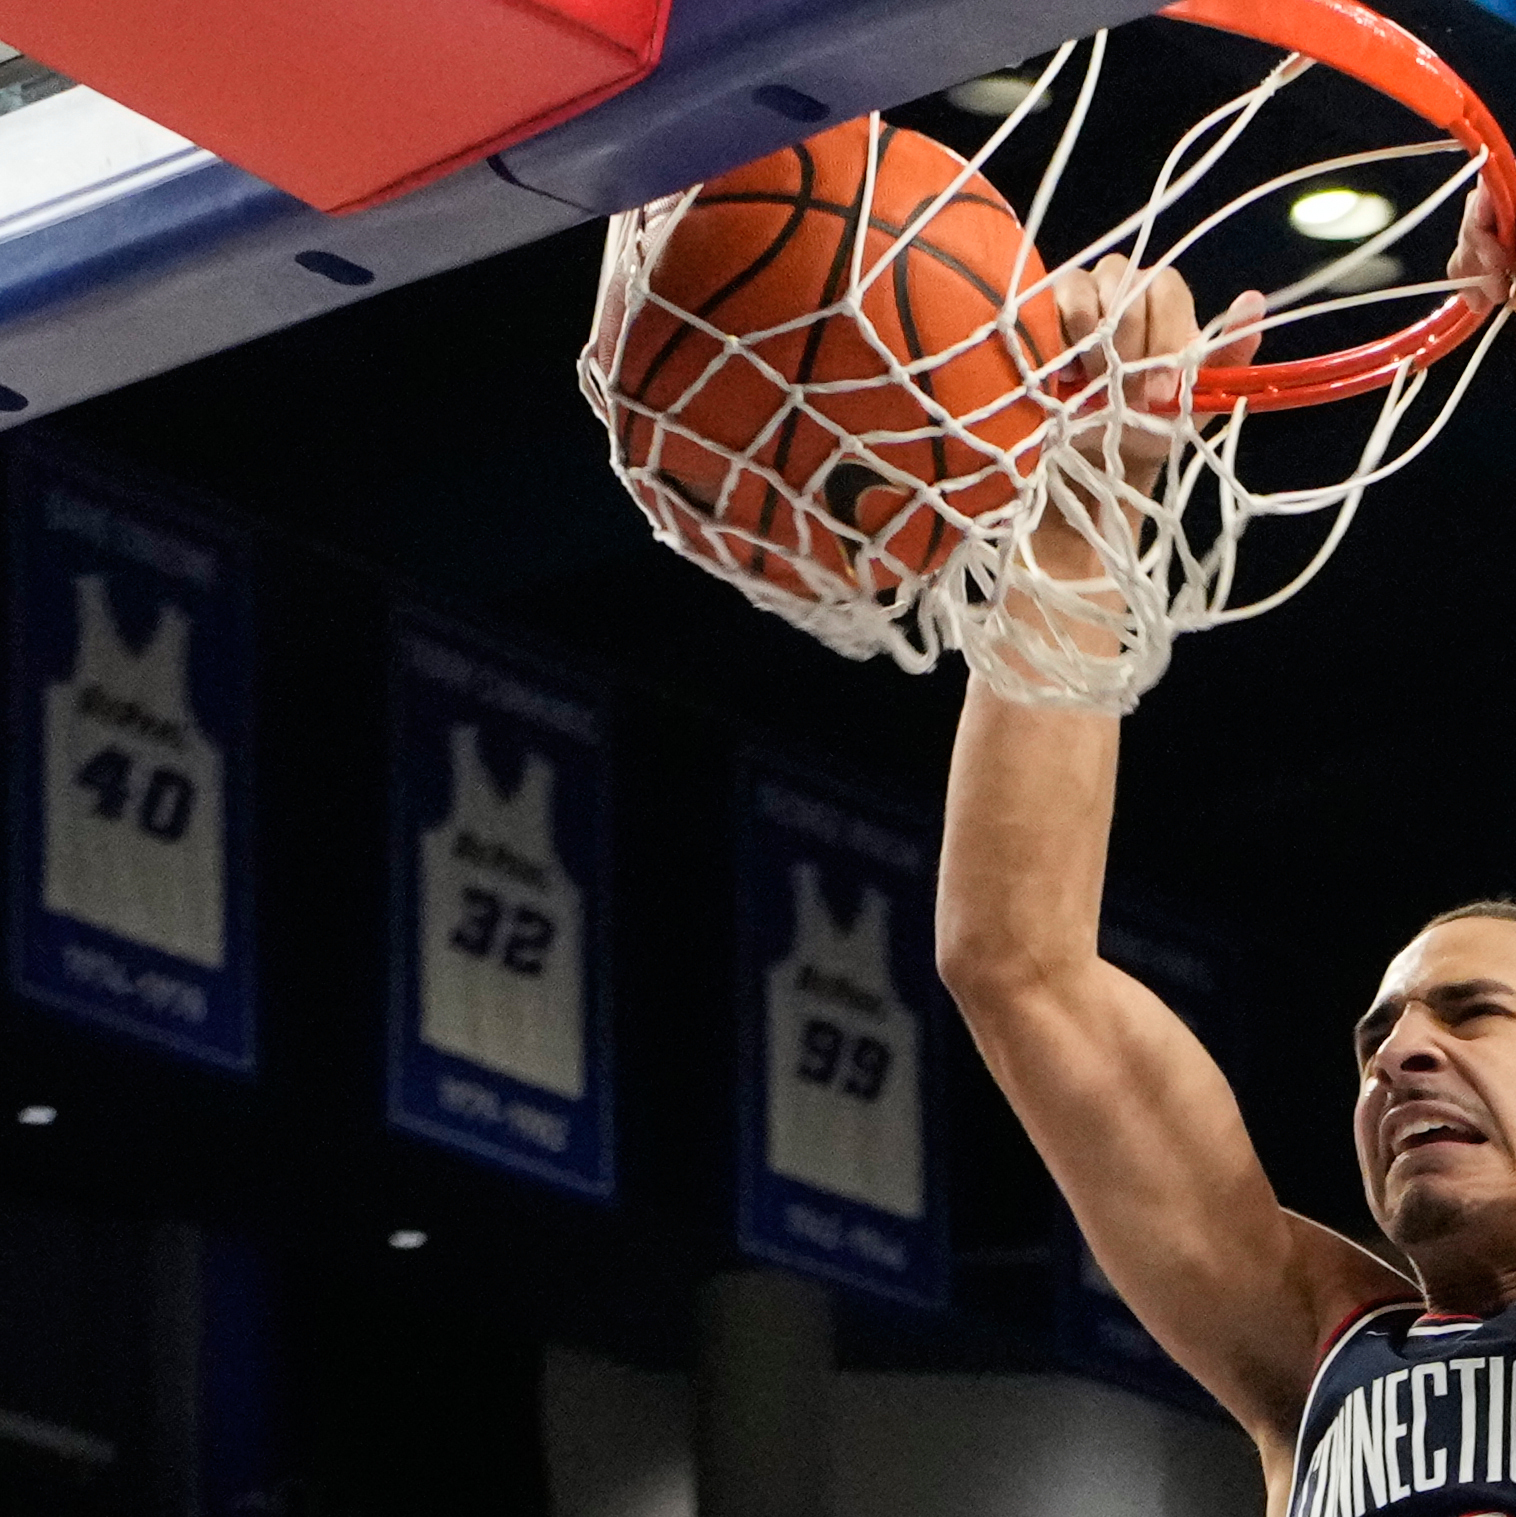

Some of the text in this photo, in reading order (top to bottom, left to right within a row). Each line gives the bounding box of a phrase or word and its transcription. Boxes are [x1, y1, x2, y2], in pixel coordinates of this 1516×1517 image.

[78, 746, 195, 843] 40
[449, 886, 556, 976] 32
[797, 1019, 893, 1105] 99
